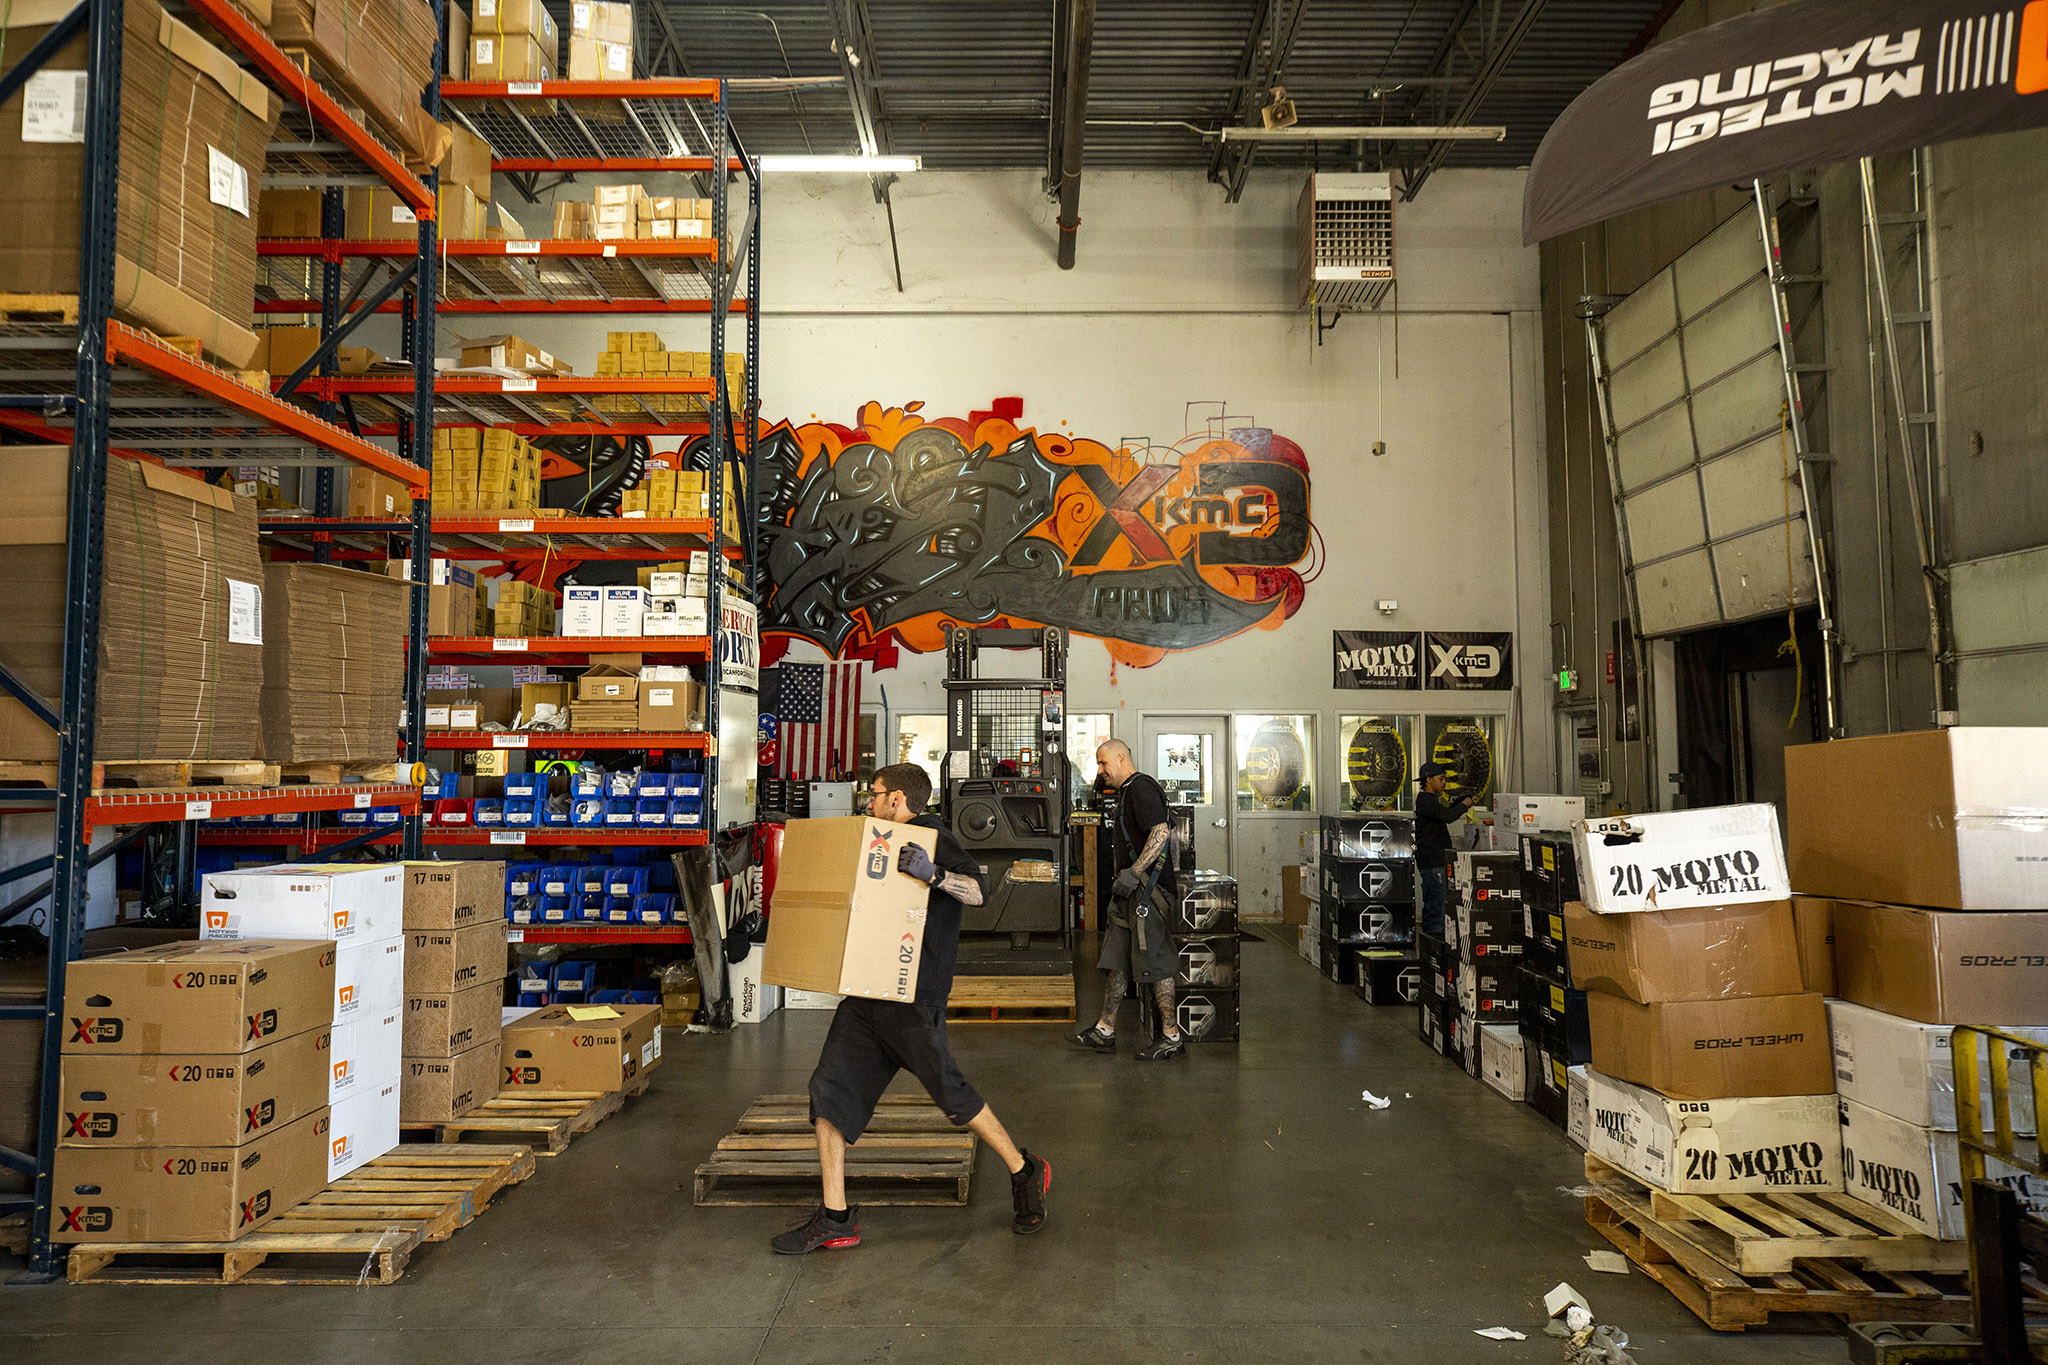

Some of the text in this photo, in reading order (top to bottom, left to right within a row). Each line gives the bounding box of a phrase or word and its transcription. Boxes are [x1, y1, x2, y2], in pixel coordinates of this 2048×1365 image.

[1648, 28, 1922, 120] RACING
[1651, 64, 1925, 156] MOTEGI
[1337, 644, 1416, 672] MOTO
[1429, 645, 1500, 677] XD
[1366, 665, 1417, 677] METAL
[866, 826, 893, 881] XD
[413, 873, 426, 884] 17
[1610, 850, 1760, 896] 20 MOTO
[311, 885, 322, 893] 17
[1487, 889, 1521, 898] FUE
[1697, 876, 1767, 895] METAL
[414, 935, 427, 947] 17
[1487, 944, 1523, 954] FUE
[1571, 936, 1616, 952] WHEEL PROS
[325, 951, 335, 967] 20
[899, 945, 914, 964] 20
[1960, 955, 2048, 967] EL PROS
[186, 971, 205, 988] 20
[409, 999, 422, 1011] 17
[741, 977, 749, 1019] American
[747, 983, 756, 1012] Racing
[1492, 999, 1519, 1009] FU
[69, 1017, 124, 1044] XD
[246, 1008, 278, 1042] XD
[321, 1032, 331, 1049] 20
[581, 1036, 594, 1047] 20
[1694, 1033, 1803, 1050] WHEEL PROS
[182, 1065, 201, 1082] 20
[411, 1064, 424, 1076] 17
[504, 1067, 541, 1085] XD
[63, 1112, 119, 1138] XD
[244, 1098, 276, 1134] XD
[319, 1117, 329, 1135] 20
[1607, 1127, 1625, 1145] META
[177, 1158, 196, 1175] 20
[1686, 1148, 1718, 1180] 20
[1725, 1142, 1823, 1180] MOTO
[1764, 1169, 1828, 1186] METAL
[1859, 1159, 1921, 1201] MOTO
[238, 1189, 271, 1229] XD
[1881, 1190, 1926, 1223] METAL
[57, 1205, 113, 1233] XD
